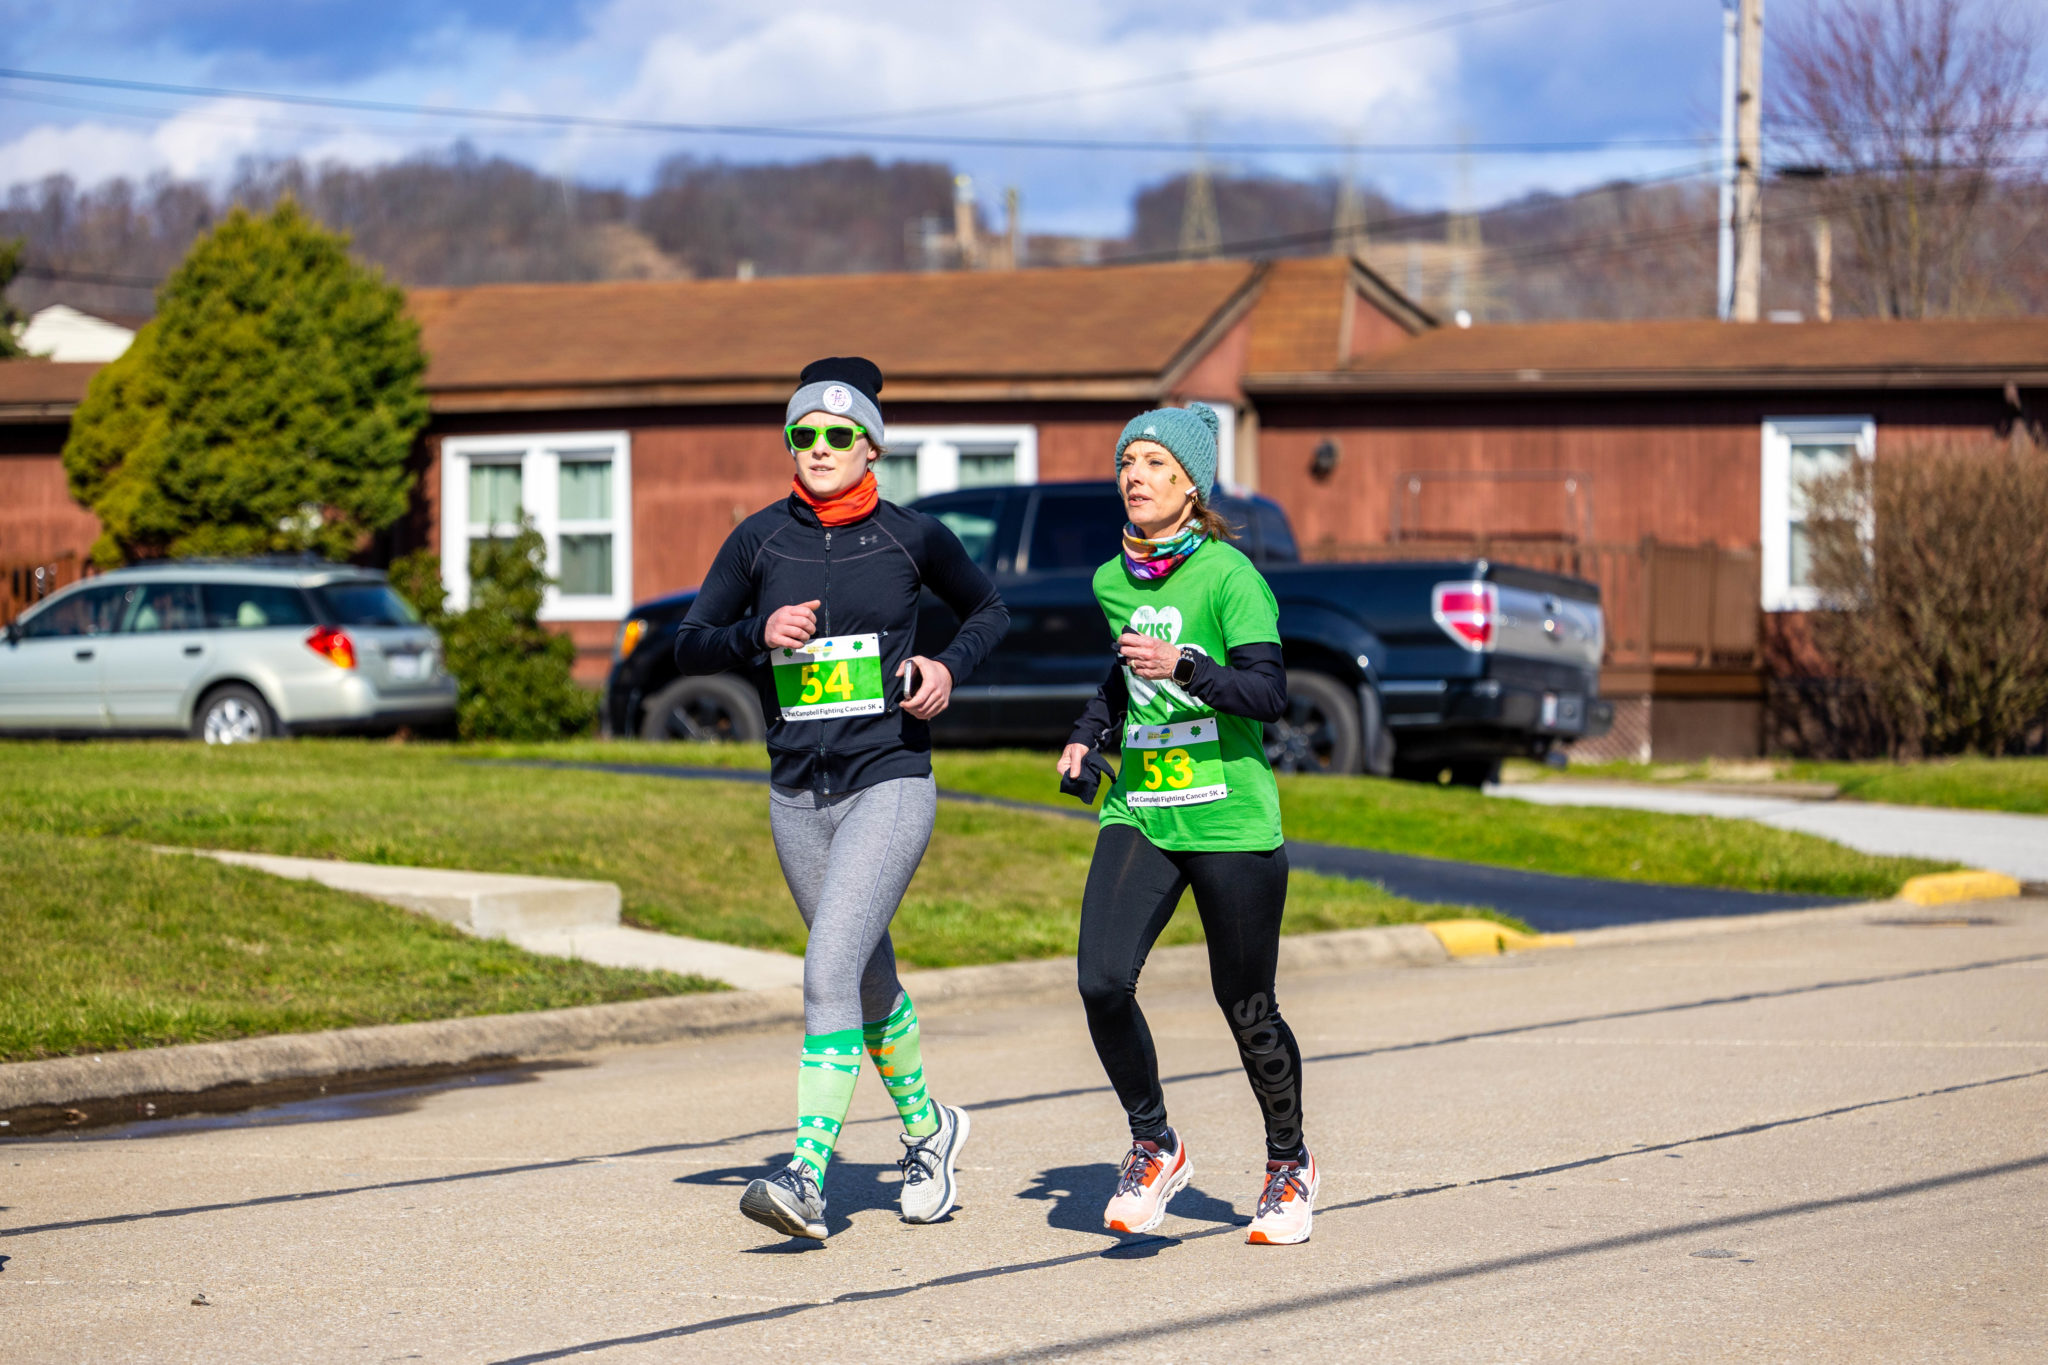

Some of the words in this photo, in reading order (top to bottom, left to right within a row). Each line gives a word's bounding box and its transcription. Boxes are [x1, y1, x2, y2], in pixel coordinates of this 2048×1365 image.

[1137, 622, 1172, 643] KISS
[801, 660, 854, 704] 54
[796, 709, 820, 717] Campbell
[820, 706, 844, 715] Fighting
[845, 704, 866, 712] Cancer
[1143, 748, 1193, 790] 53
[1140, 795, 1160, 803] Campbell
[1161, 794, 1185, 803] Fighting
[1185, 792, 1208, 800] Cancer
